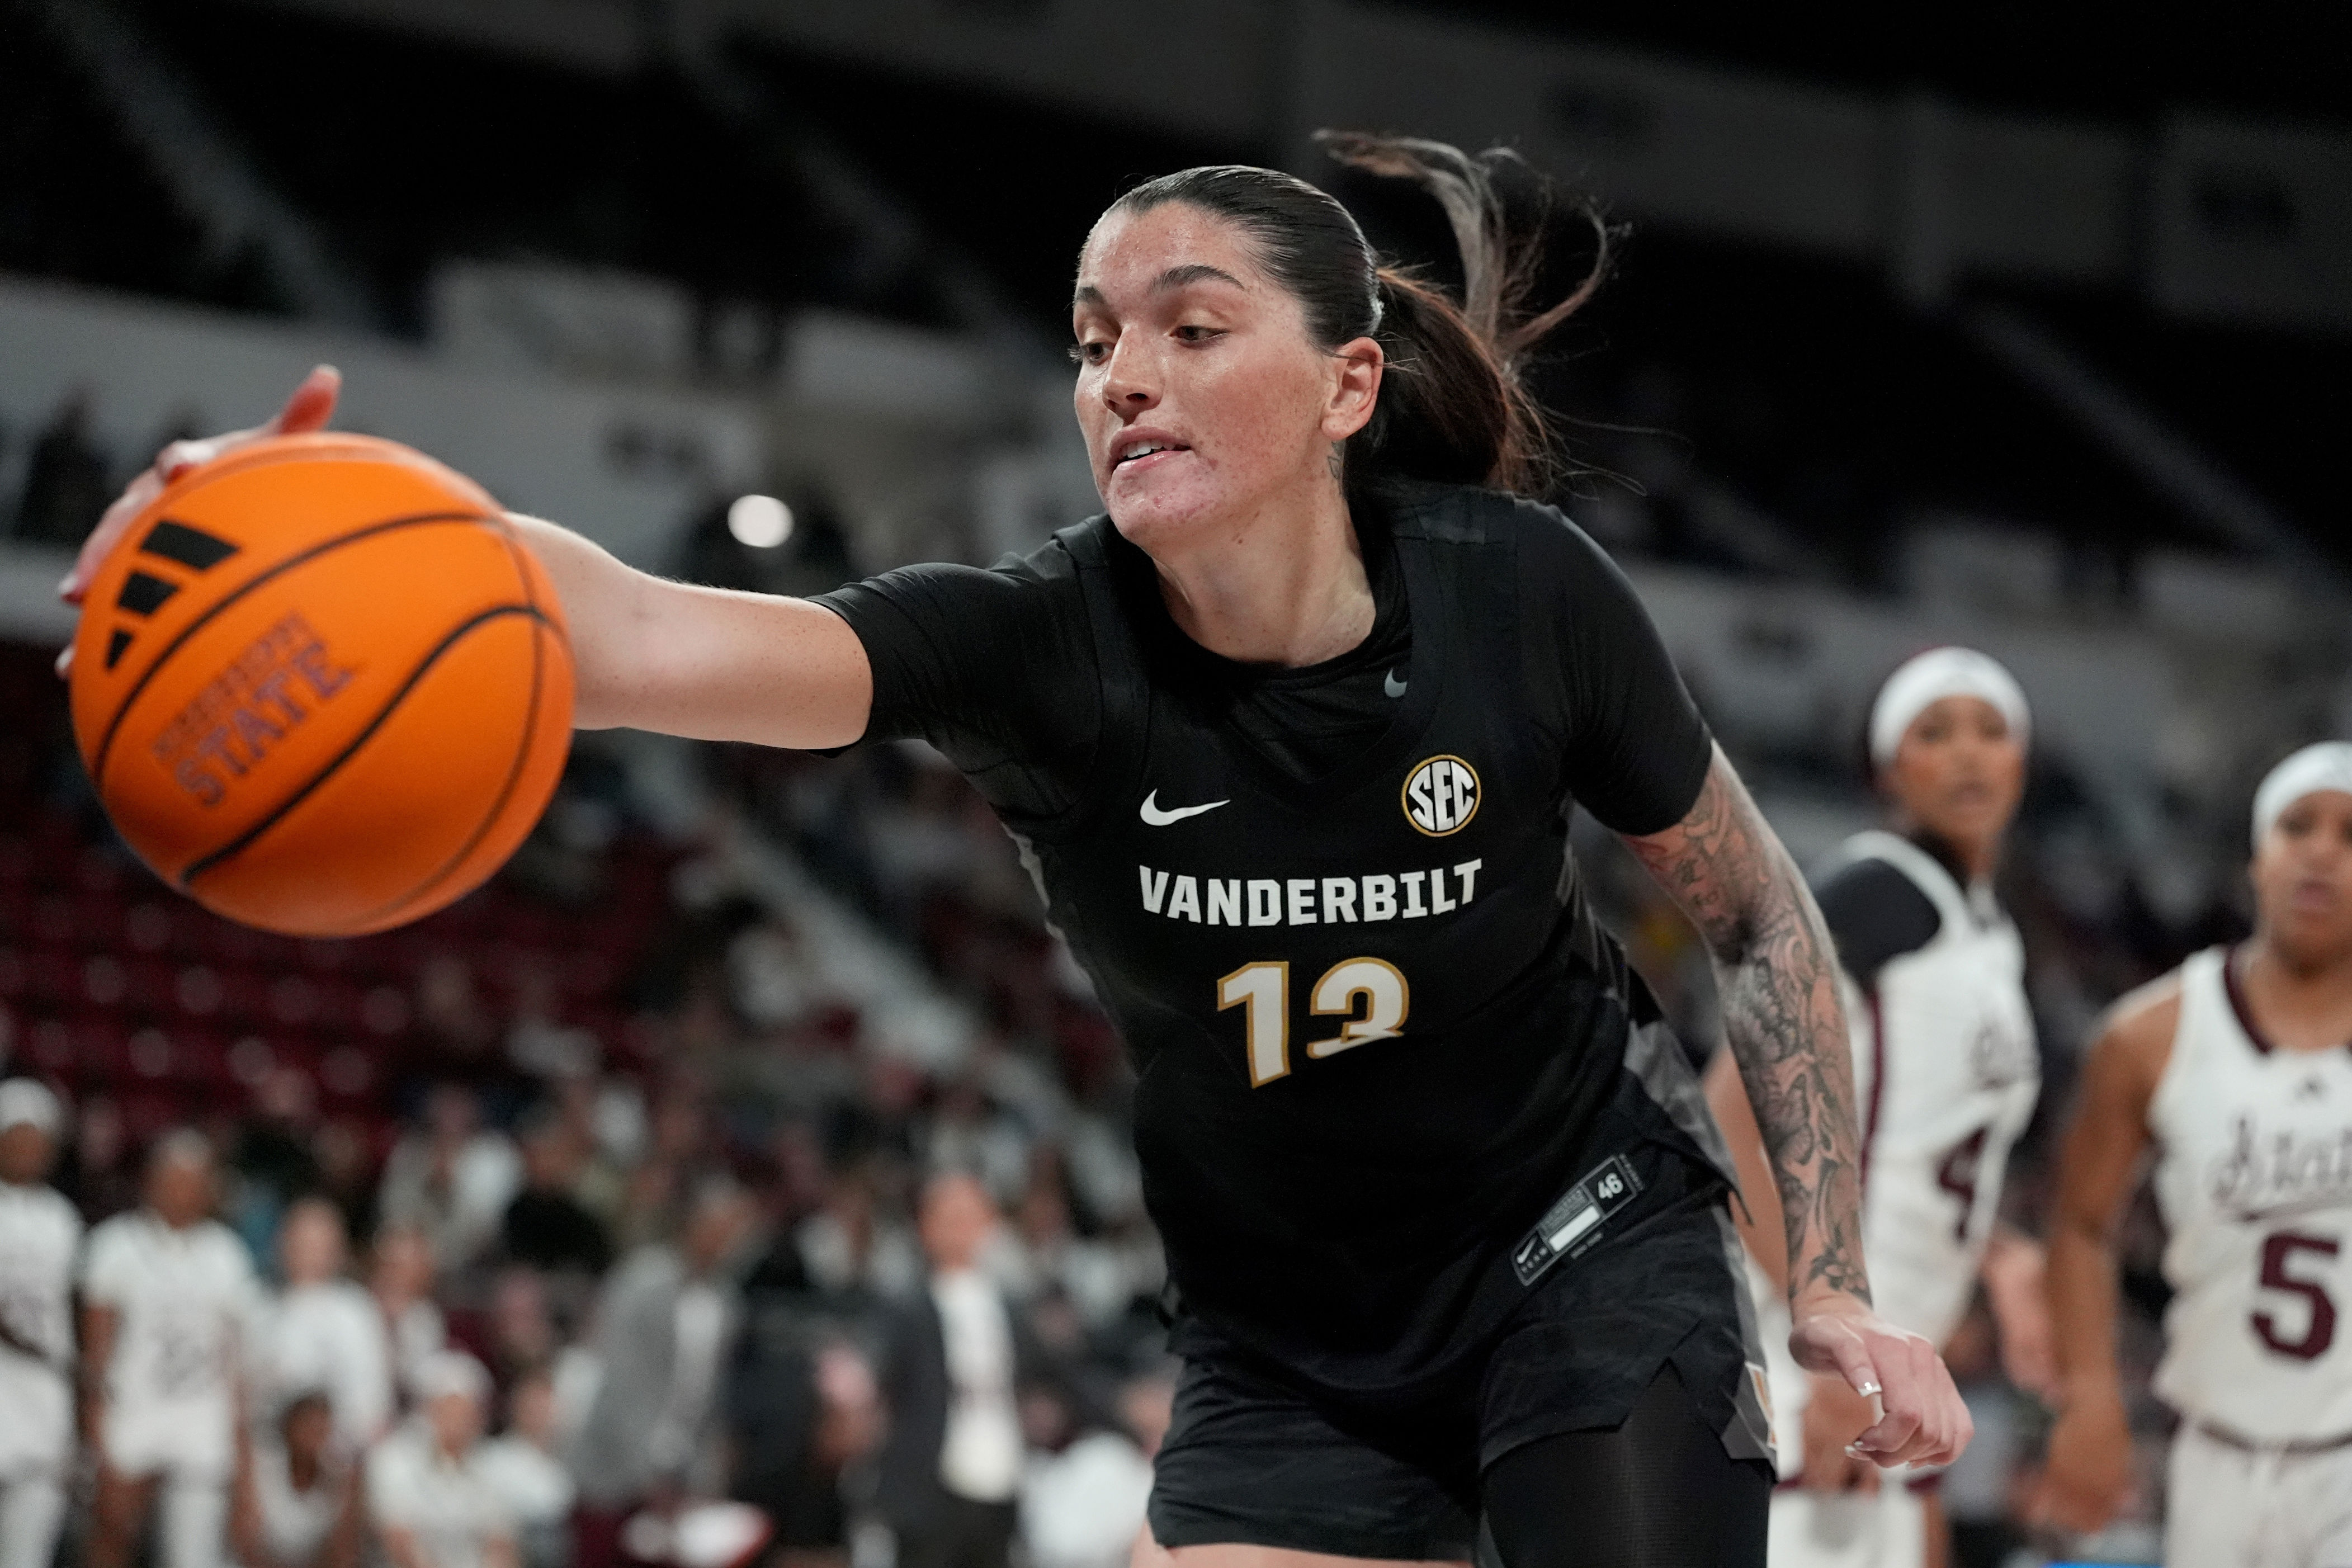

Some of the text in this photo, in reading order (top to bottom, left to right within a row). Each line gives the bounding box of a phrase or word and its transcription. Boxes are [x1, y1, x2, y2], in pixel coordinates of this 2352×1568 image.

[174, 639, 357, 809] STATE
[1409, 761, 1475, 832] SEC
[1139, 858, 1482, 927] VANDERBILT
[1598, 1172, 1623, 1198] 46
[2251, 1233, 2340, 1361] 5
